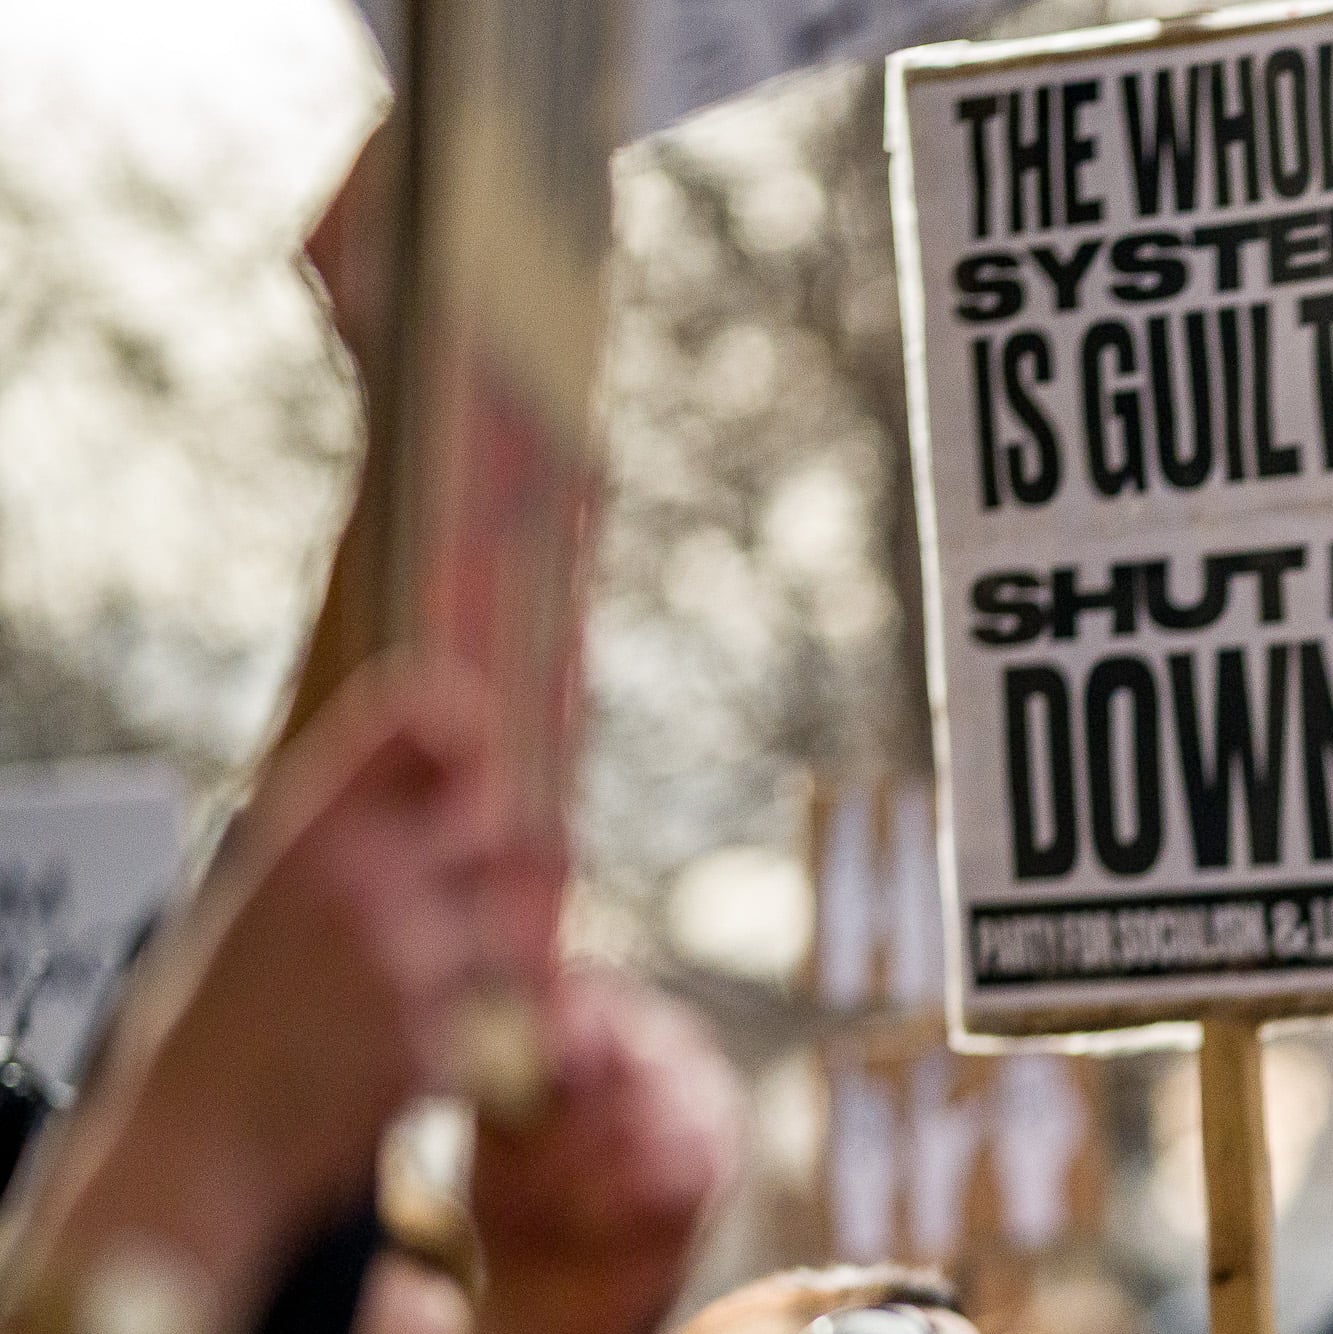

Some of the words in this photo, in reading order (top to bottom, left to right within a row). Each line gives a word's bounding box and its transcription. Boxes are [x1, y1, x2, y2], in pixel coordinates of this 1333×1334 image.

[955, 79, 1107, 239] THE
[971, 330, 1063, 512] IS
[969, 542, 1308, 648] SHUT
[1272, 899, 1310, 957] &
